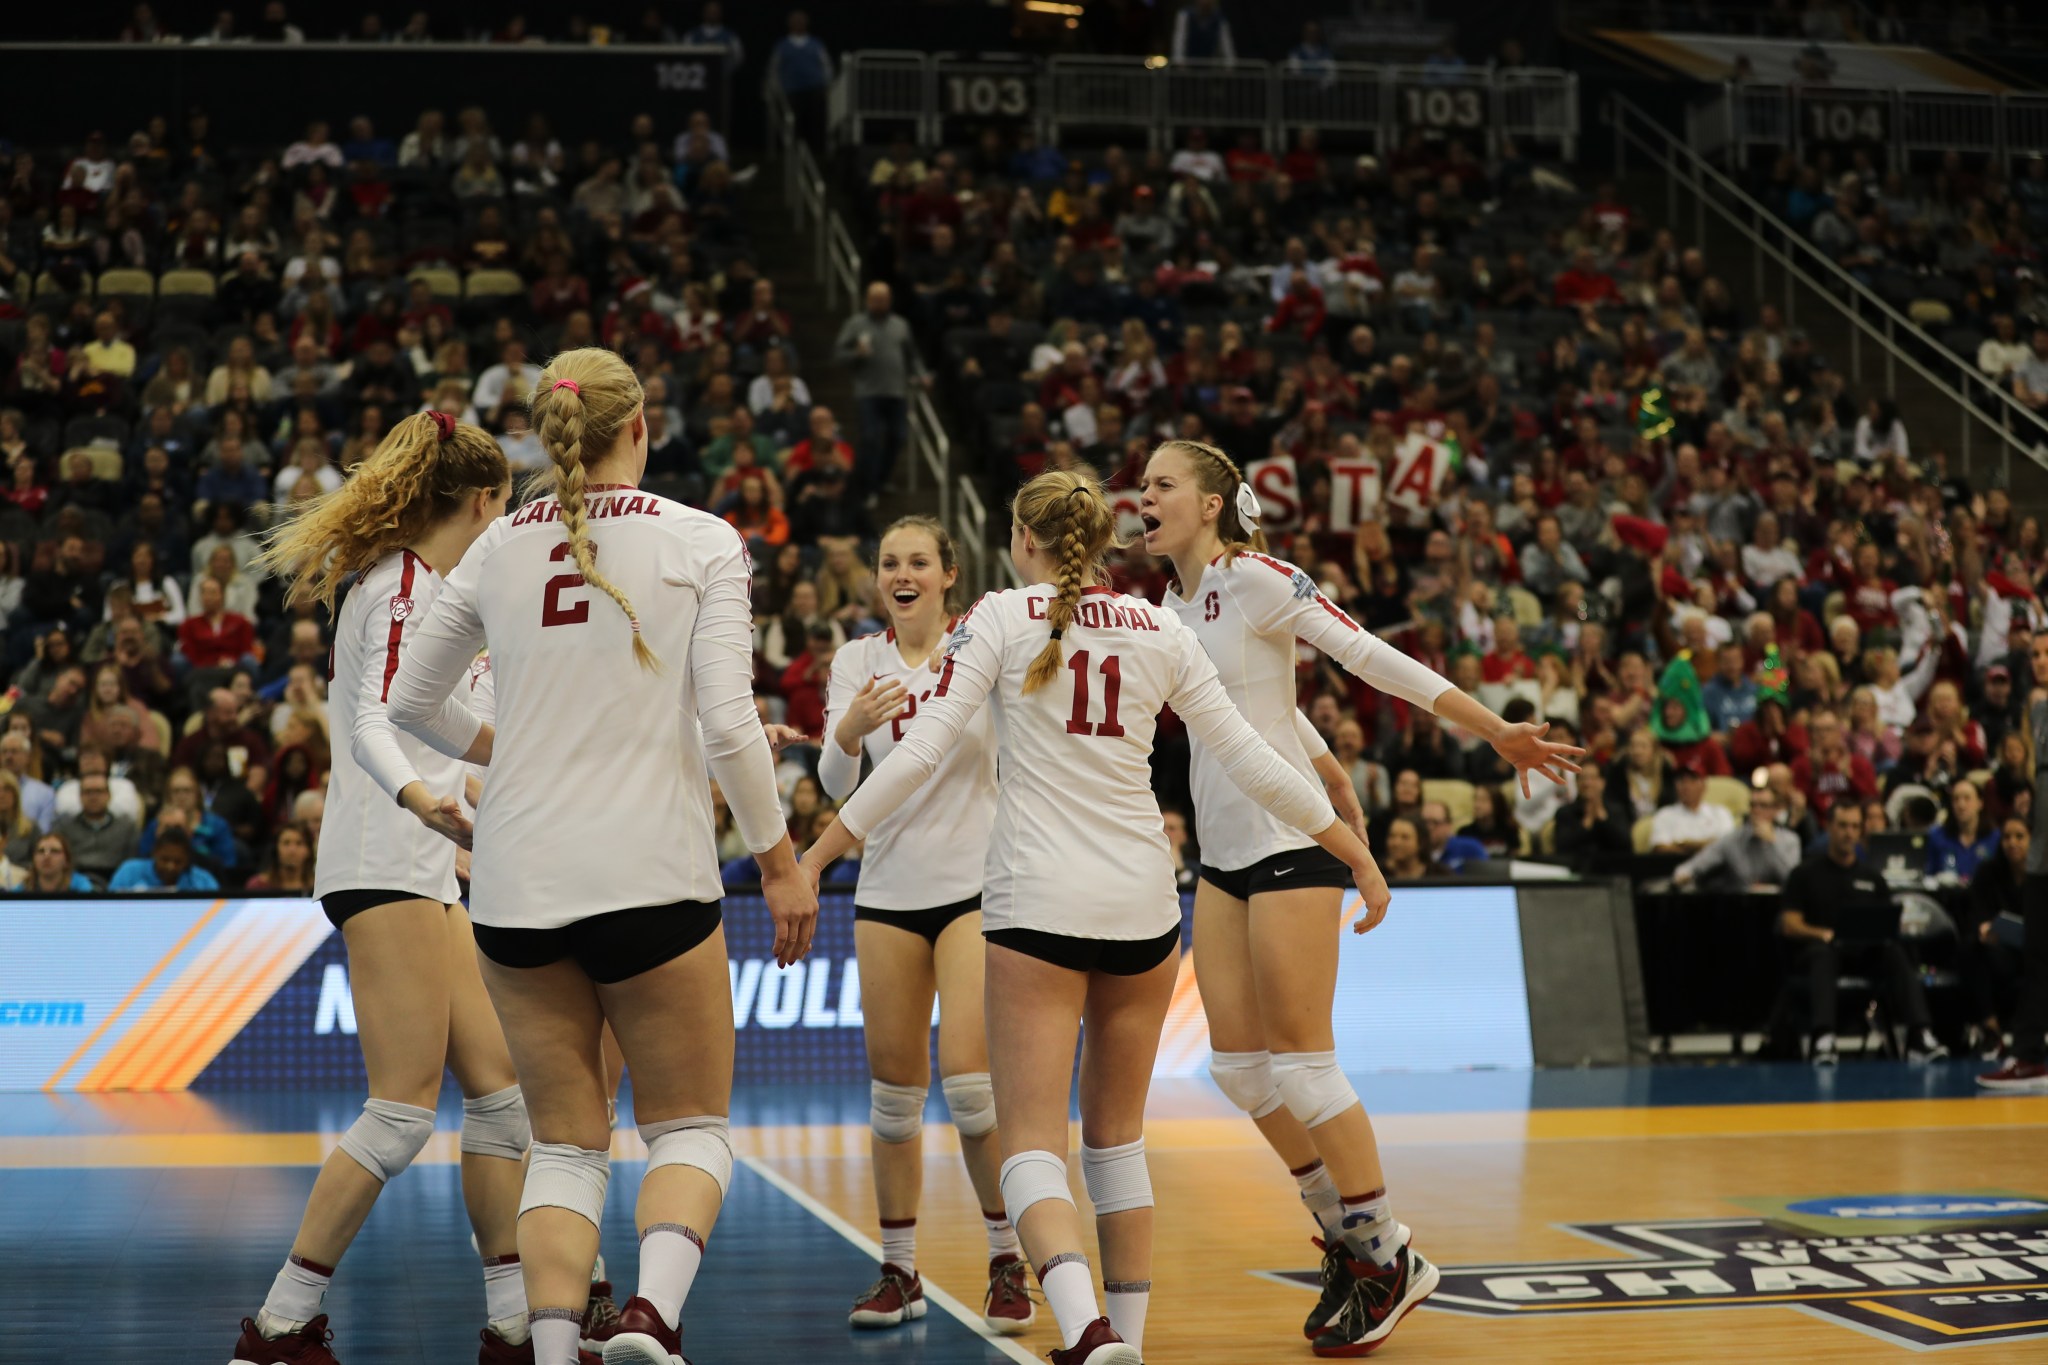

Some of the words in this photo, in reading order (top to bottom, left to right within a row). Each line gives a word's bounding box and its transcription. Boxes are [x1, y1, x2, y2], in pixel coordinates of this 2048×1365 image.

[656, 61, 708, 91] 102
[949, 77, 1027, 116] 103
[1407, 88, 1481, 128] 103
[1811, 104, 1884, 142] 104
[511, 496, 661, 527] CARINAL
[541, 540, 598, 627] 2
[393, 607, 406, 618] 12
[1027, 596, 1160, 631] CDINAL
[1066, 650, 1125, 737] 11
